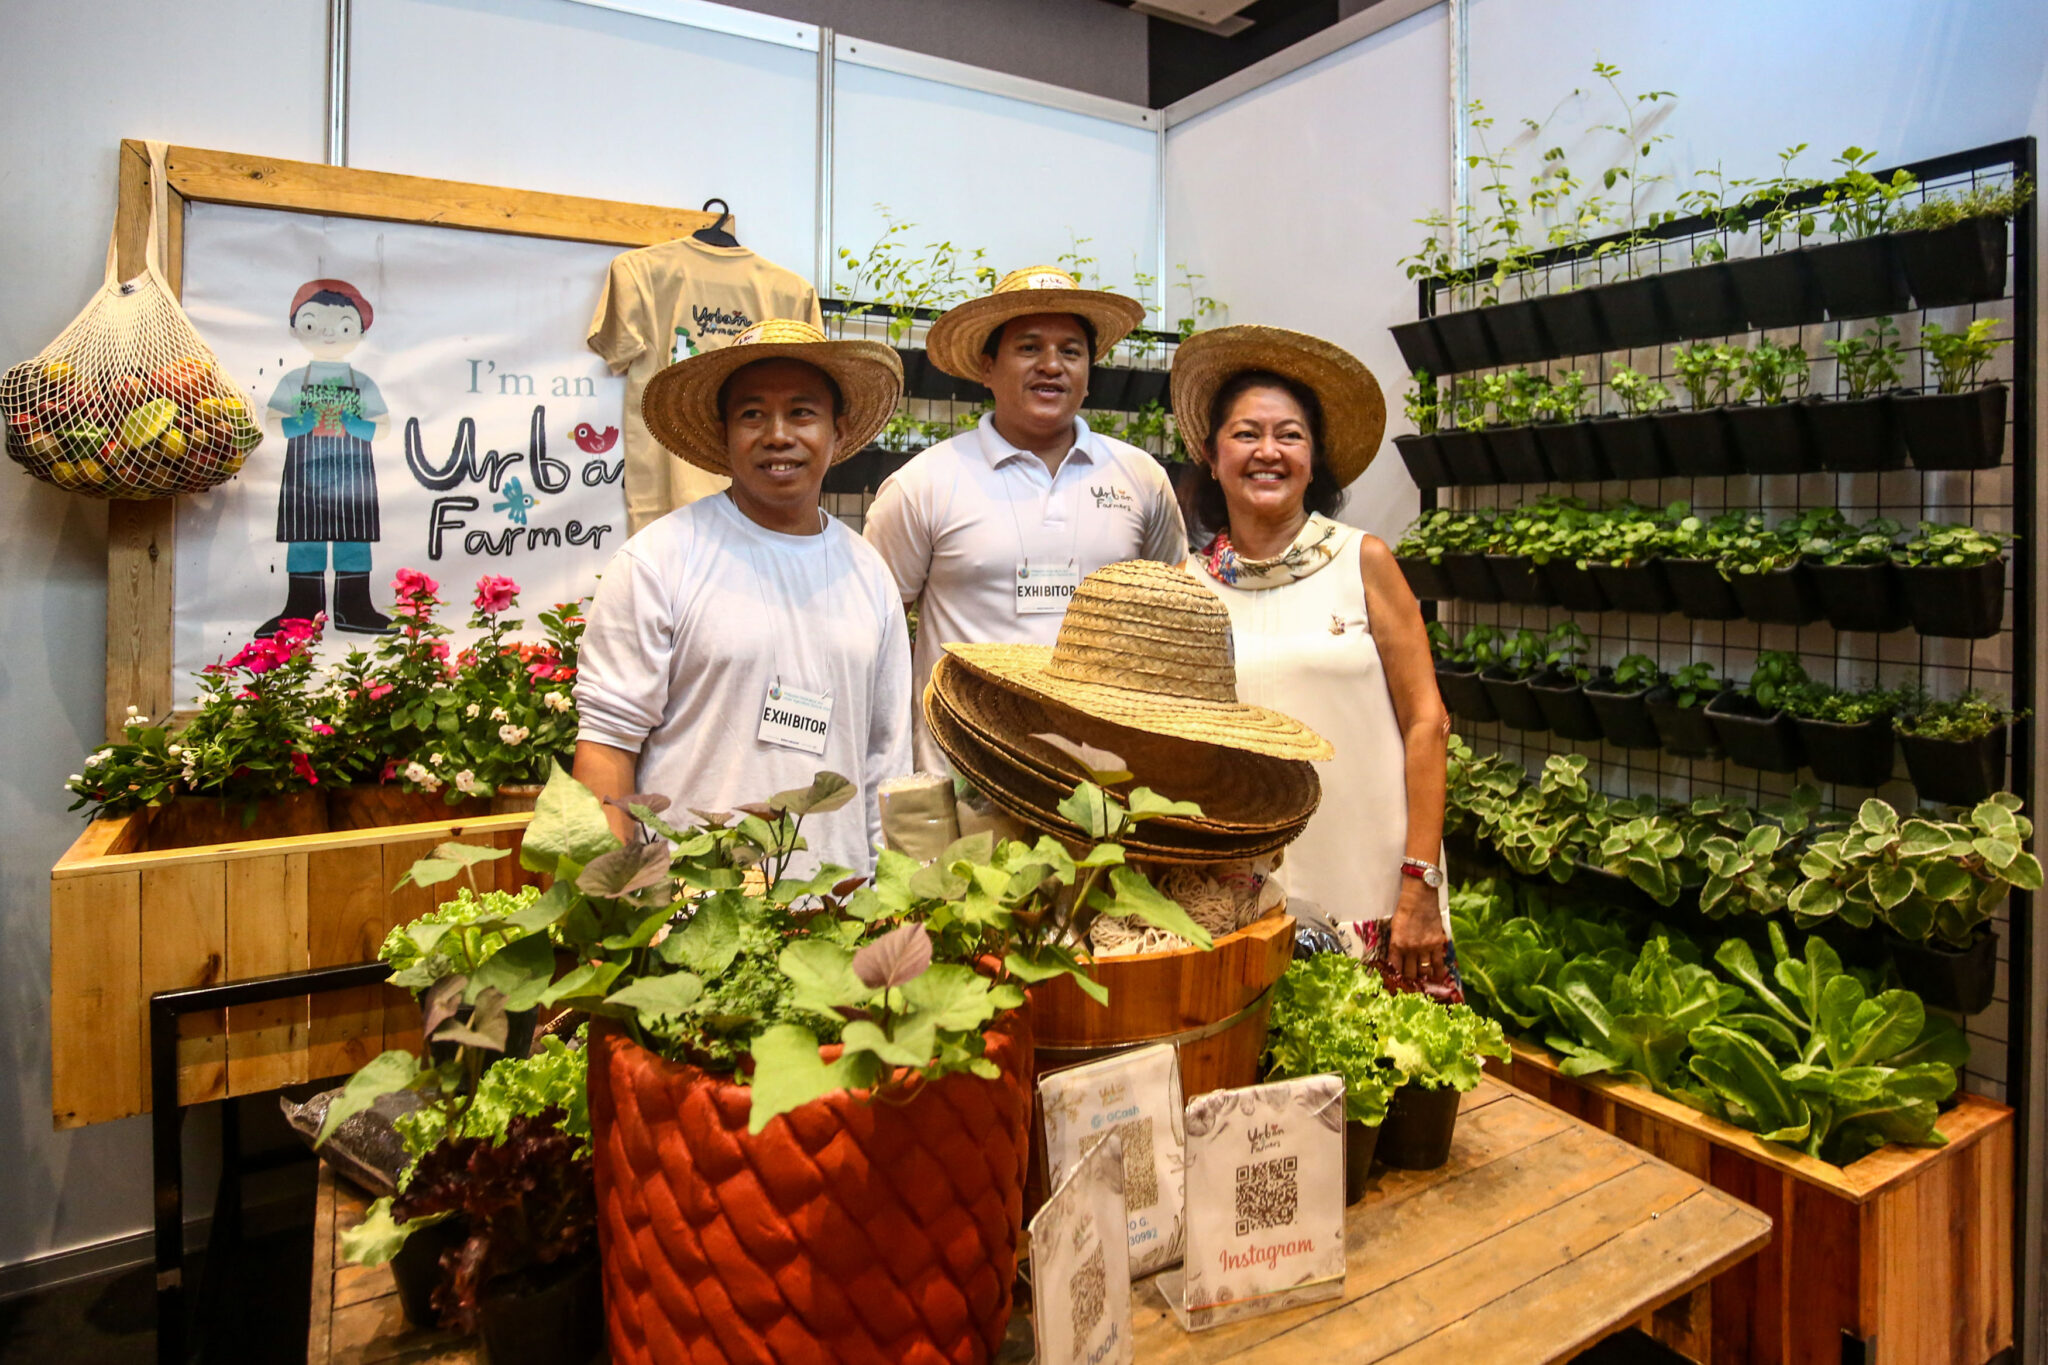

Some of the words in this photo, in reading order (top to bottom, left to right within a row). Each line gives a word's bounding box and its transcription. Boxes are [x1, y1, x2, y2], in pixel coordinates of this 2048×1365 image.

[692, 304, 752, 327] Urban
[551, 375, 598, 397] an
[1090, 485, 1133, 501] Urban
[428, 496, 612, 560] Farmer
[763, 706, 827, 735] EXHIBITOR
[1247, 1122, 1285, 1143] Urban
[1219, 1239, 1316, 1272] Instagram
